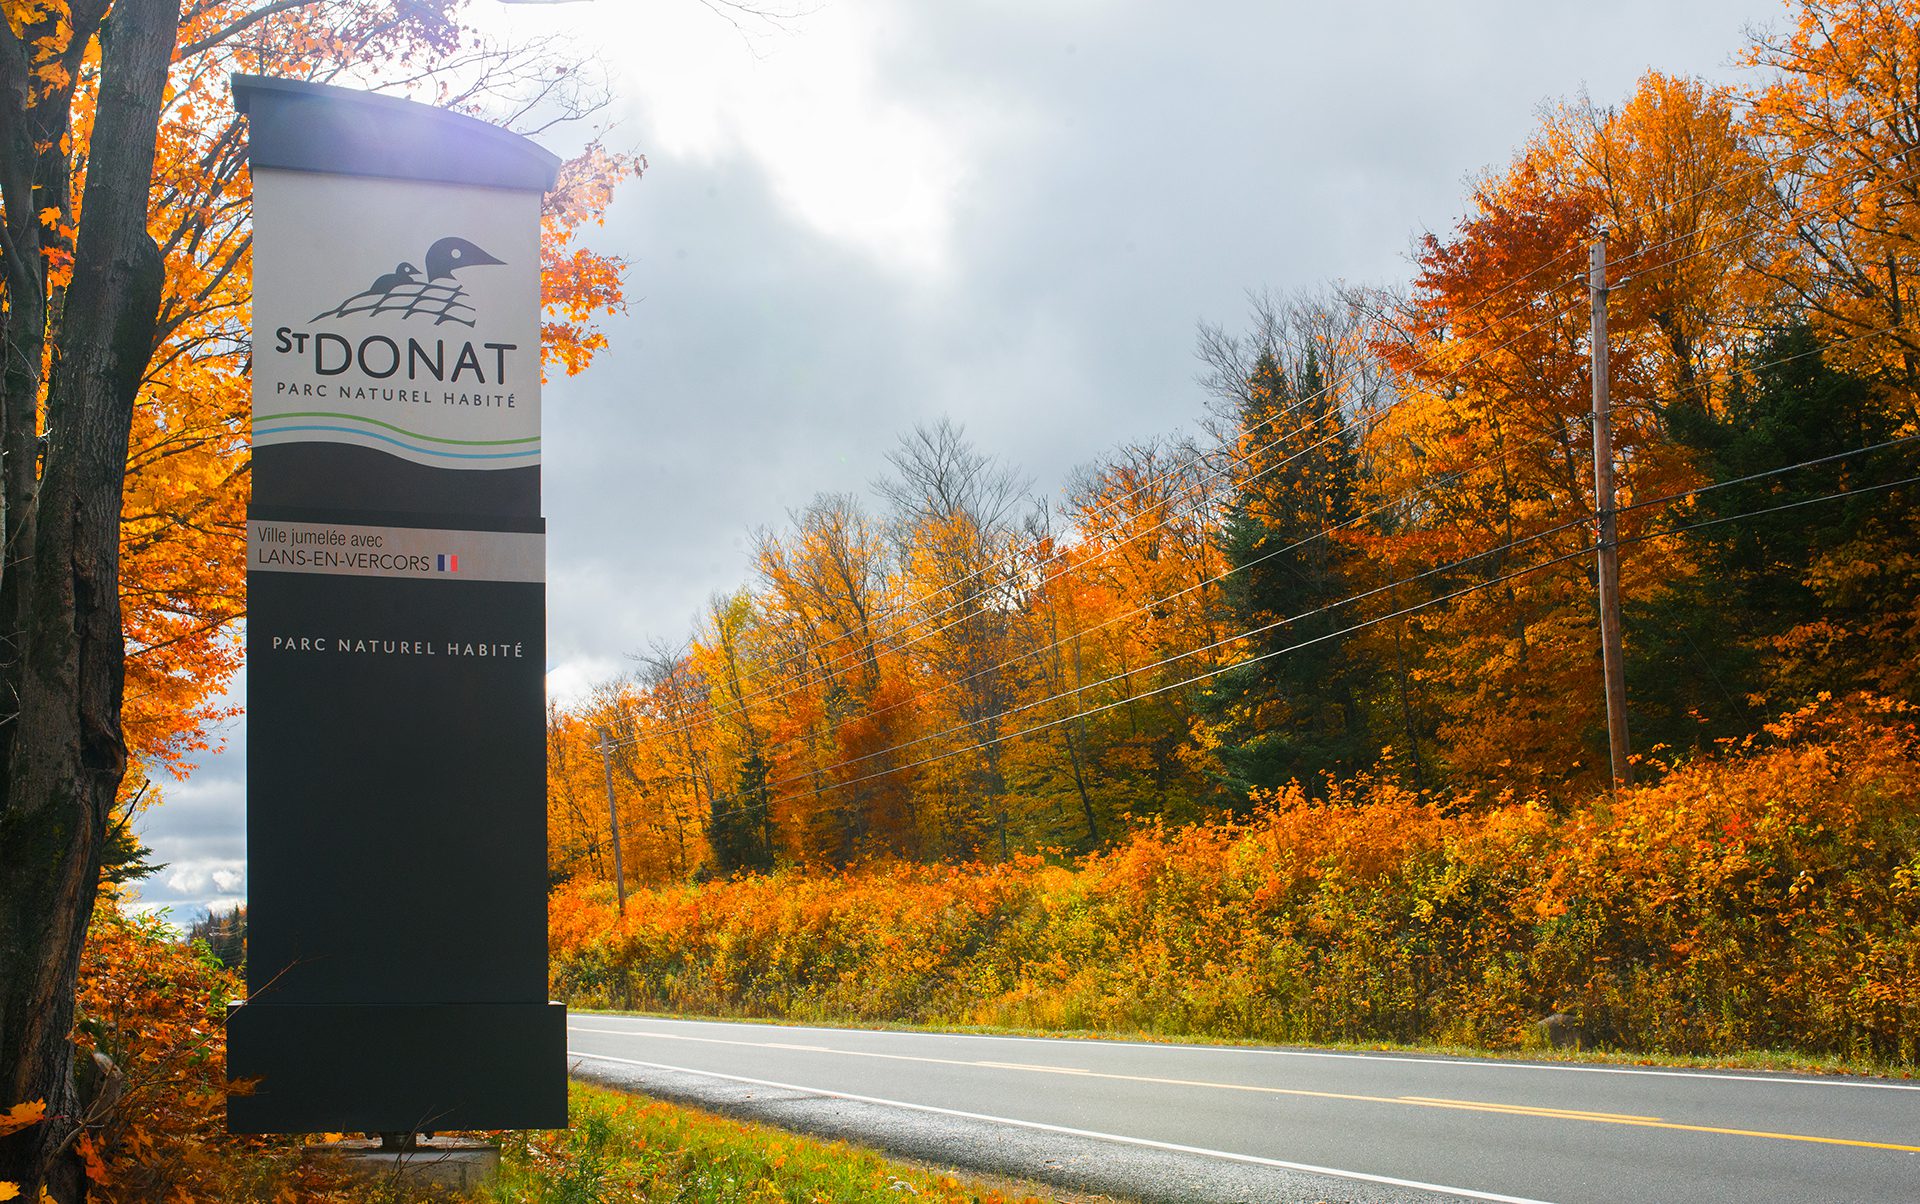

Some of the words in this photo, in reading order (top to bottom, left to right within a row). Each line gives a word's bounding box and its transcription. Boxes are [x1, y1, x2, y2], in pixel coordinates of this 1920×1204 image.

[315, 333, 517, 385] DONAT
[277, 382, 327, 398] PARC
[340, 386, 432, 403] NATUREL
[444, 393, 516, 408] HABITÉ
[258, 527, 287, 543] Ville
[291, 529, 346, 547] jumelée
[351, 534, 383, 548] avec
[258, 549, 430, 571] LANS-EN-VERCORS
[273, 637, 326, 651] PARC
[338, 639, 435, 655] NATUREL
[448, 642, 523, 657] HABITÉ
